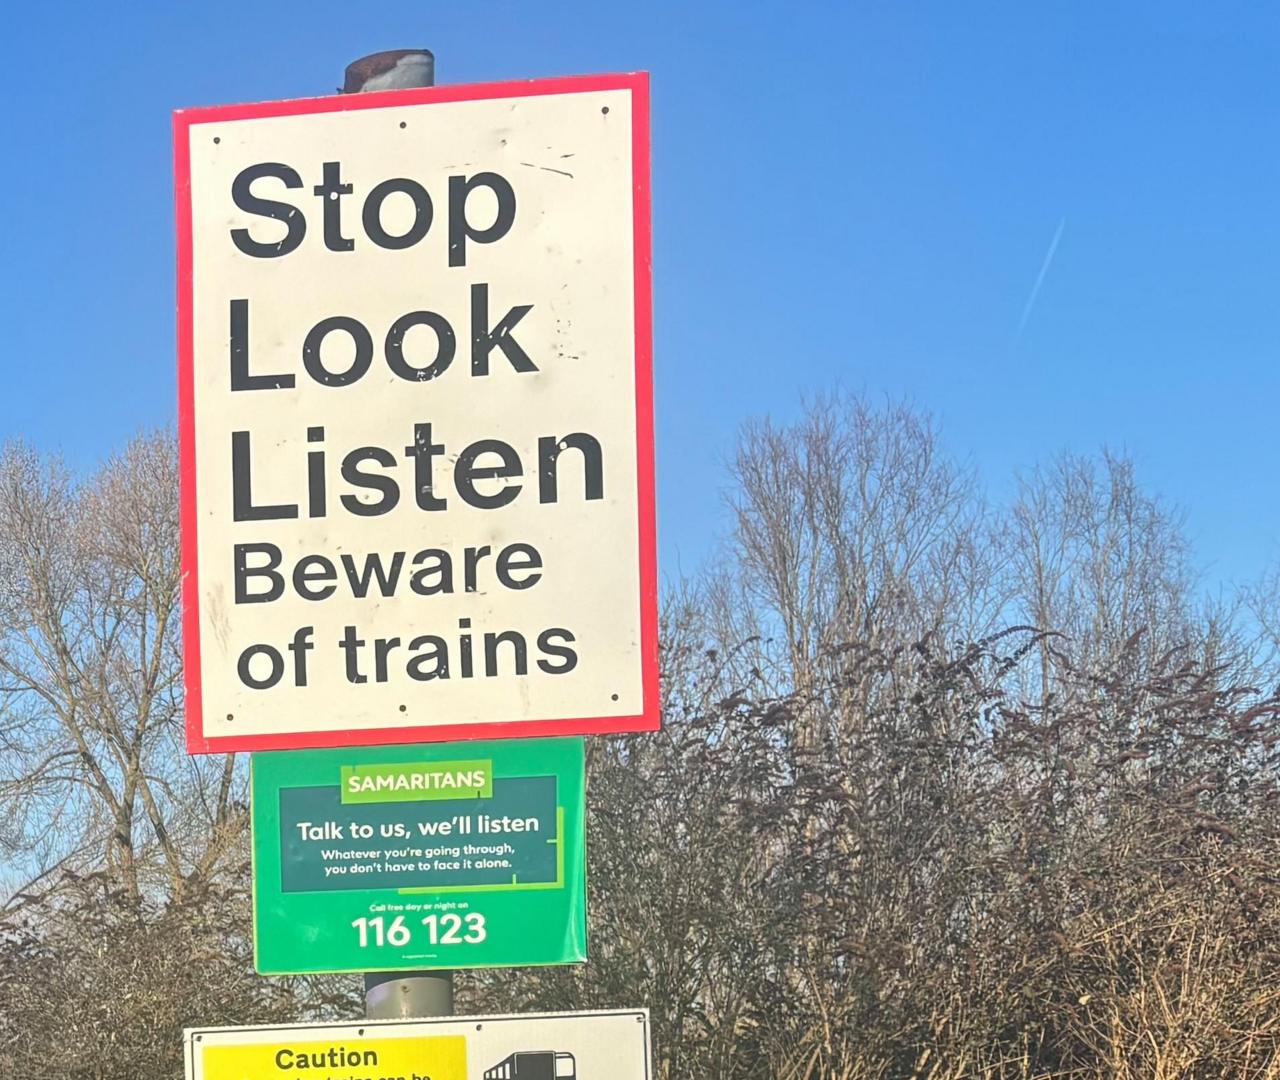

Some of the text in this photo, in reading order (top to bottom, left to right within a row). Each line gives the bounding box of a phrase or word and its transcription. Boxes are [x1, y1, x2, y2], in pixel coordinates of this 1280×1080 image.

[230, 160, 517, 268] Stop
[230, 282, 540, 391] Look
[231, 422, 605, 522] Listen
[234, 540, 544, 604] Beware
[237, 617, 579, 690] of trains
[348, 770, 486, 793] SAMARITANS
[297, 815, 539, 840] Talk to us, we'll listen
[321, 849, 381, 860] Whatever
[425, 846, 460, 858] going
[463, 843, 515, 855] through,
[325, 865, 347, 876] you
[385, 862, 415, 872] have
[418, 862, 431, 871] to
[434, 860, 460, 871] face
[463, 859, 471, 869] it
[474, 859, 512, 869] alone.
[369, 904, 386, 912] Call
[405, 903, 422, 911] day
[434, 902, 456, 911] night
[352, 912, 486, 947] 116 123
[275, 1047, 378, 1071] Caution
